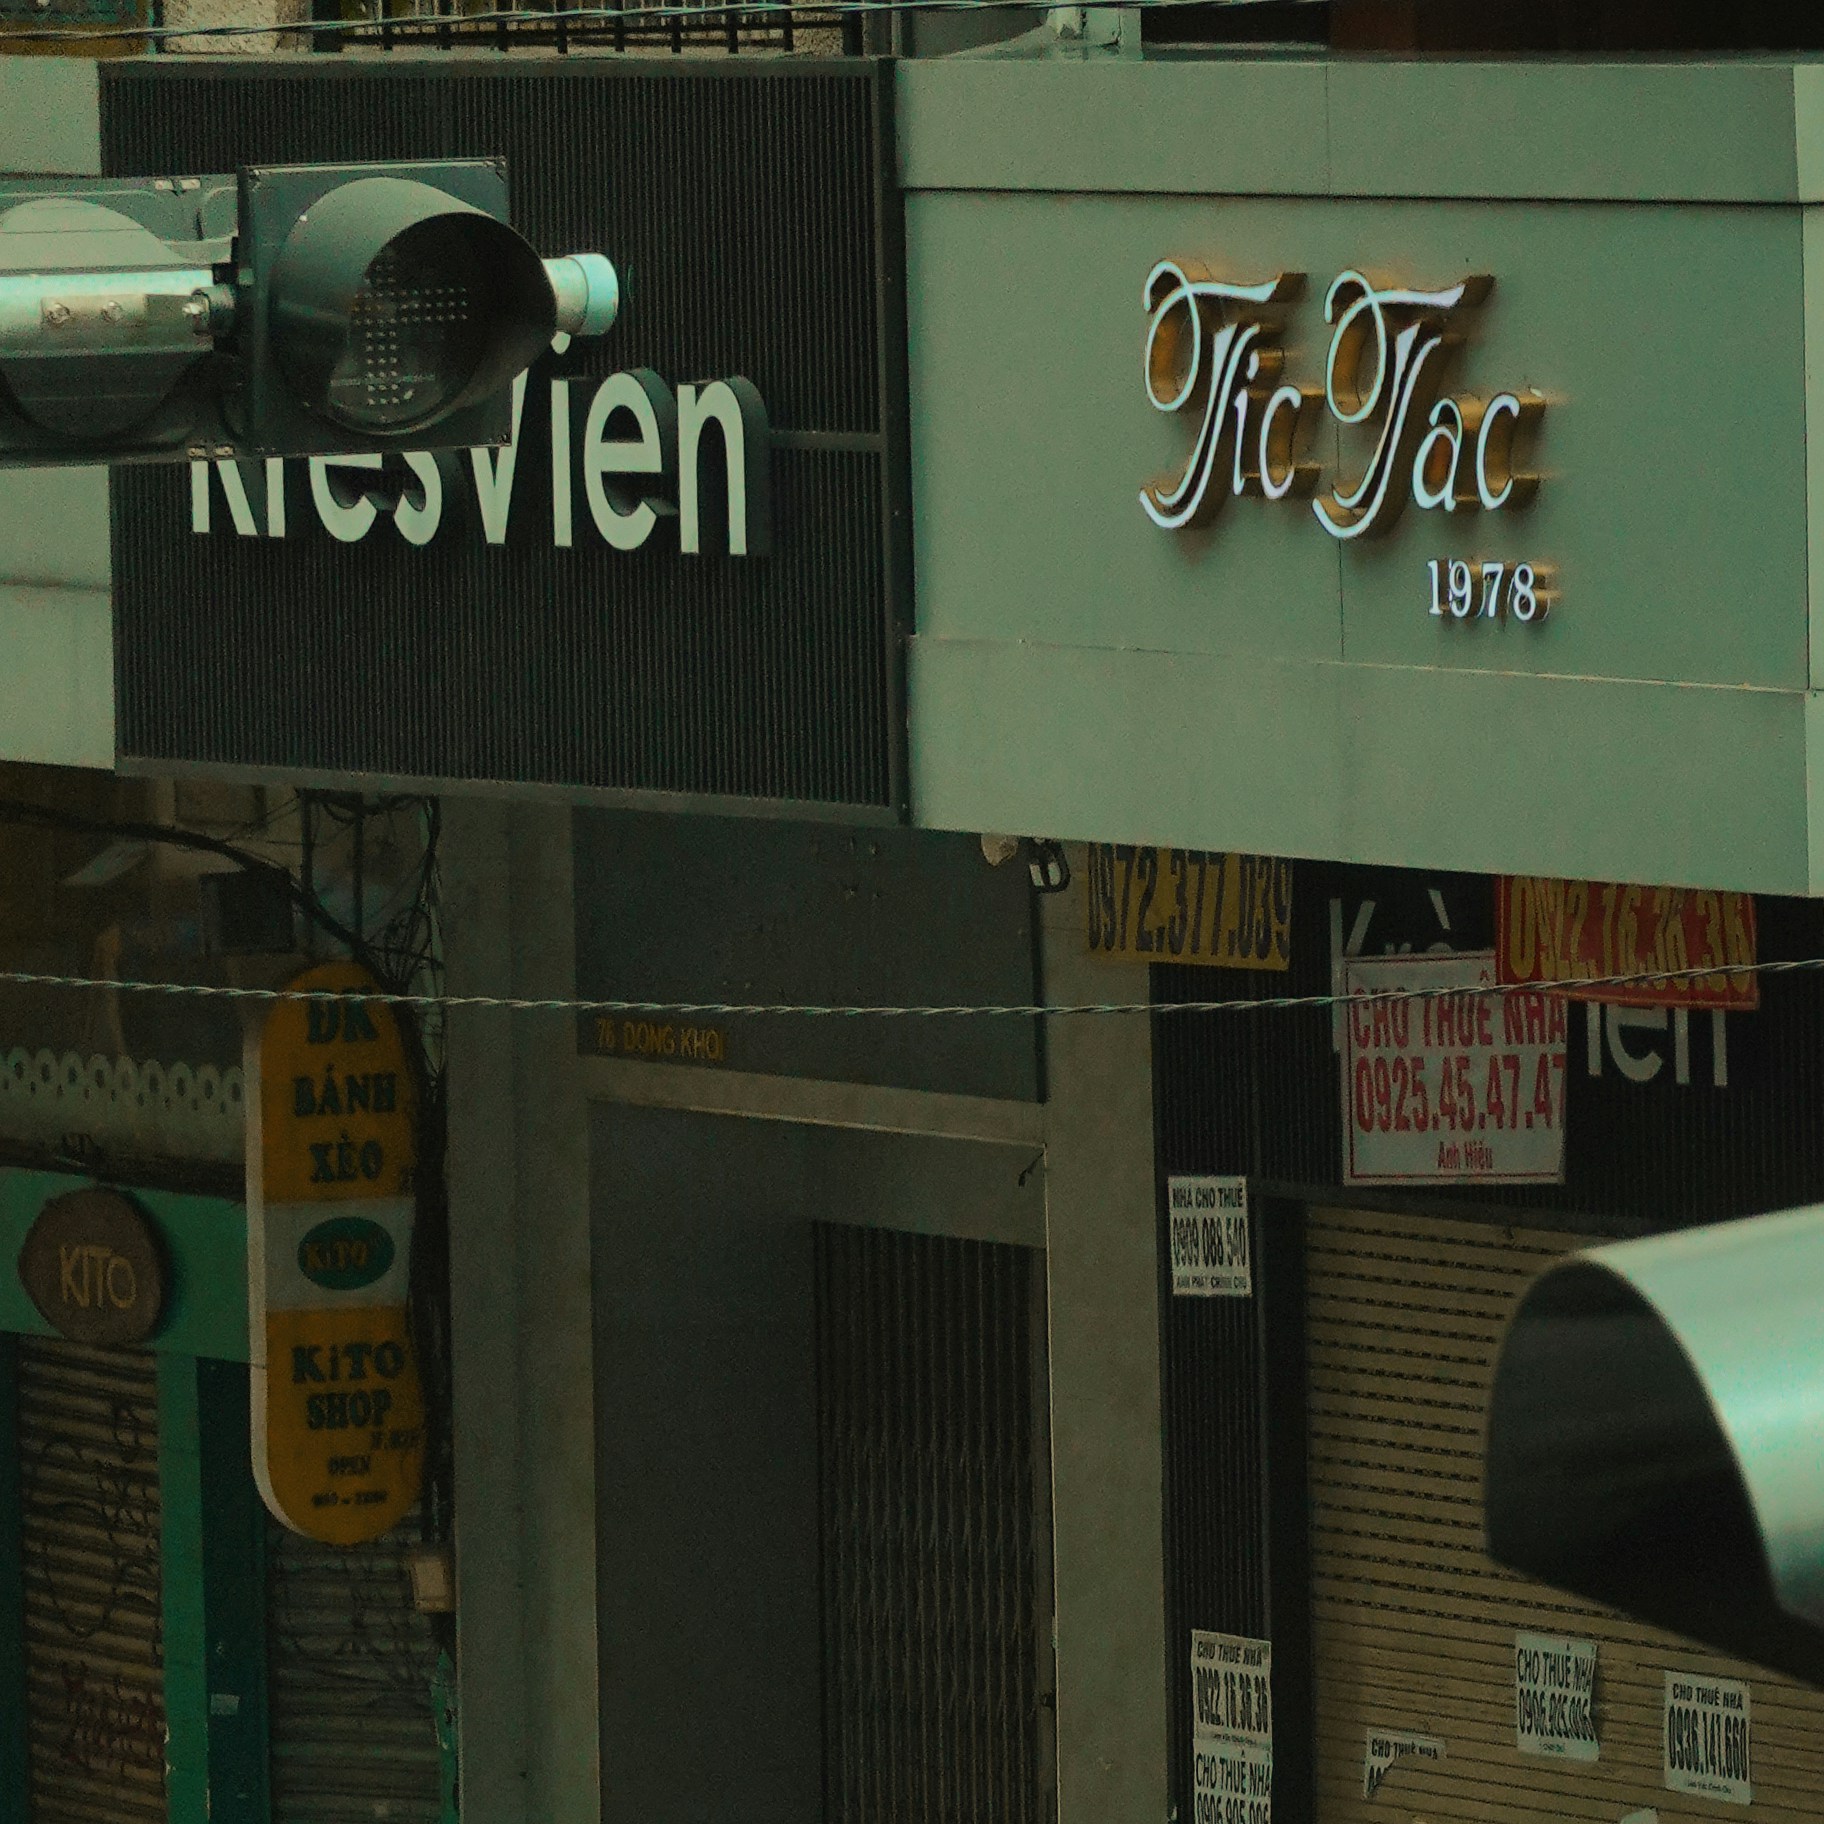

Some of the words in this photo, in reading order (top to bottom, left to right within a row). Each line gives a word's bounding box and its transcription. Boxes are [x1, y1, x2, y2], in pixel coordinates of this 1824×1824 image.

[1140, 258, 1303, 530] Tic
[1312, 269, 1519, 541] Tac
[1427, 558, 1539, 621] 1978
[1352, 988, 1409, 1049] CHO
[1354, 1053, 1566, 1134] 0925.45.47.47
[60, 1244, 137, 1310] KITO
[307, 1389, 393, 1431] SHOP
[1517, 1647, 1540, 1686] CHO
[1543, 1643, 1571, 1689] THUÊ
[1672, 1682, 1693, 1702] CHO
[1196, 1752, 1217, 1789] CHO
